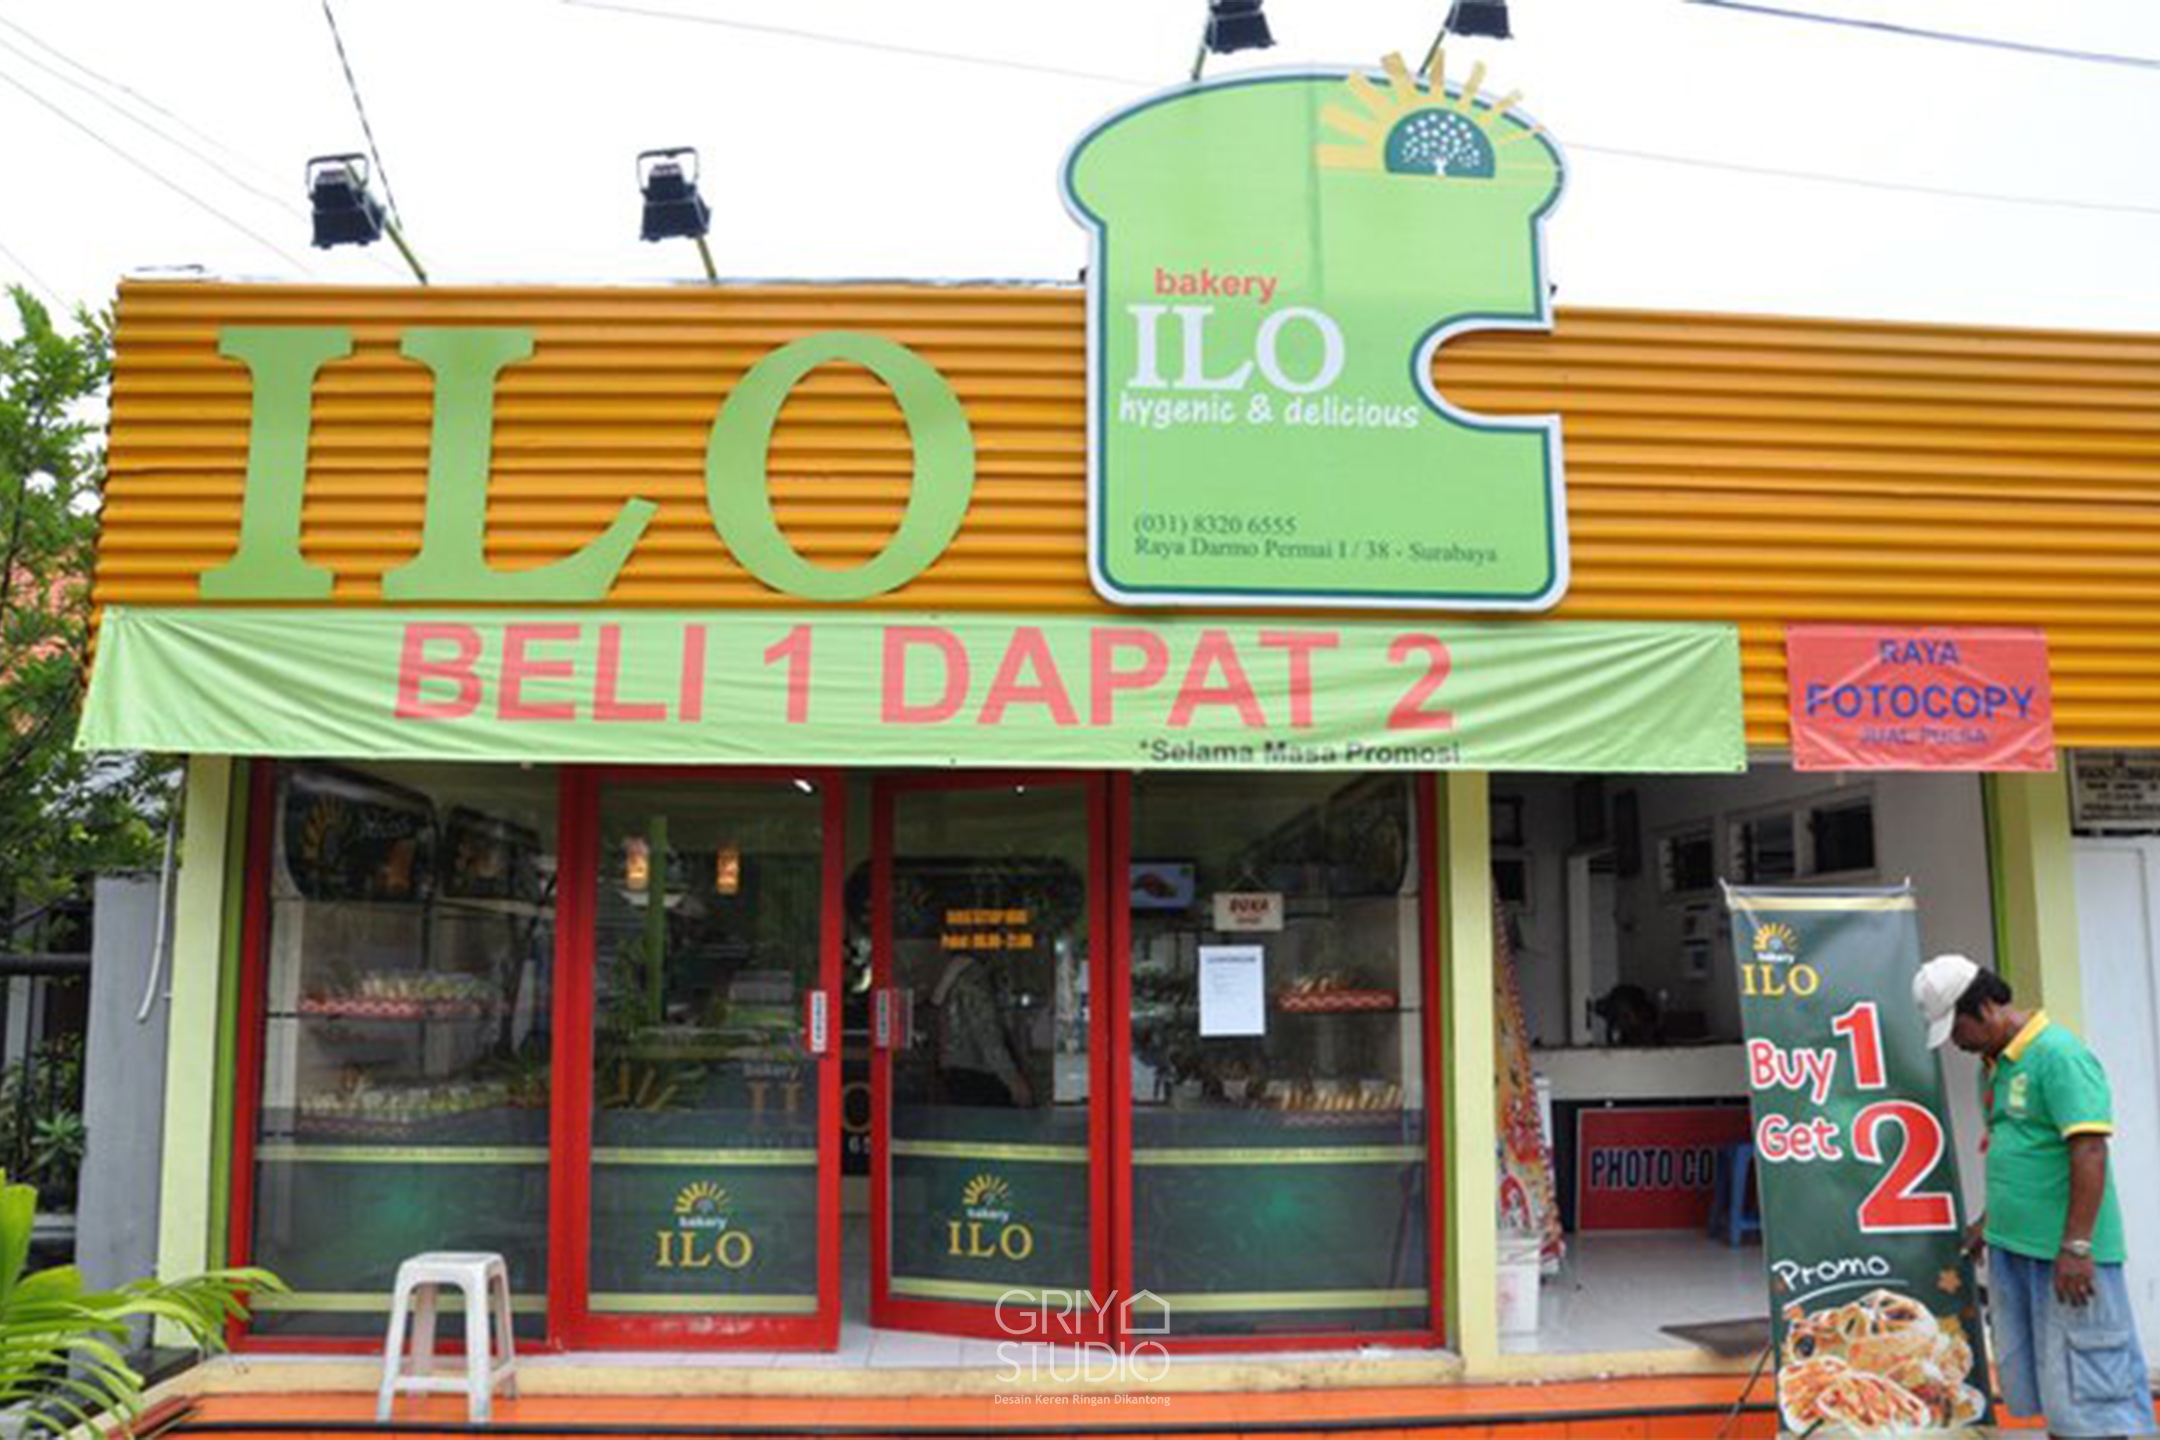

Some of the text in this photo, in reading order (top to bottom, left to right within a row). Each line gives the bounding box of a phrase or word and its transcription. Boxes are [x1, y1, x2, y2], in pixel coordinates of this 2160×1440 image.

[1154, 267, 1278, 305] bakery
[1126, 302, 1346, 394] ILO
[1118, 392, 1420, 430] hygenic & delicious
[198, 325, 977, 601] ILO
[1133, 514, 1298, 535] (031) 8320 6555
[1134, 537, 1187, 560] Raya
[1190, 538, 1259, 557] Darmo
[1264, 538, 1334, 559] Permai
[1365, 540, 1390, 560] 38
[1408, 543, 1498, 566] Surabaya
[1879, 638, 1960, 665] RAYA
[393, 622, 1455, 730] BELI 1 DAPAT 2
[1805, 682, 2034, 720] FOTOCOPY
[1264, 740, 1338, 764] Masa
[1345, 740, 1461, 765] Promosi
[1740, 963, 1820, 996] ILO
[1747, 1002, 1887, 1104] Buy 1
[1591, 1148, 1714, 1187] PHOTO CO
[1757, 1099, 1958, 1234] Get 2
[656, 1231, 753, 1268] ILO
[948, 1221, 1033, 1260] ILO
[1771, 1254, 1891, 1292] Promo
